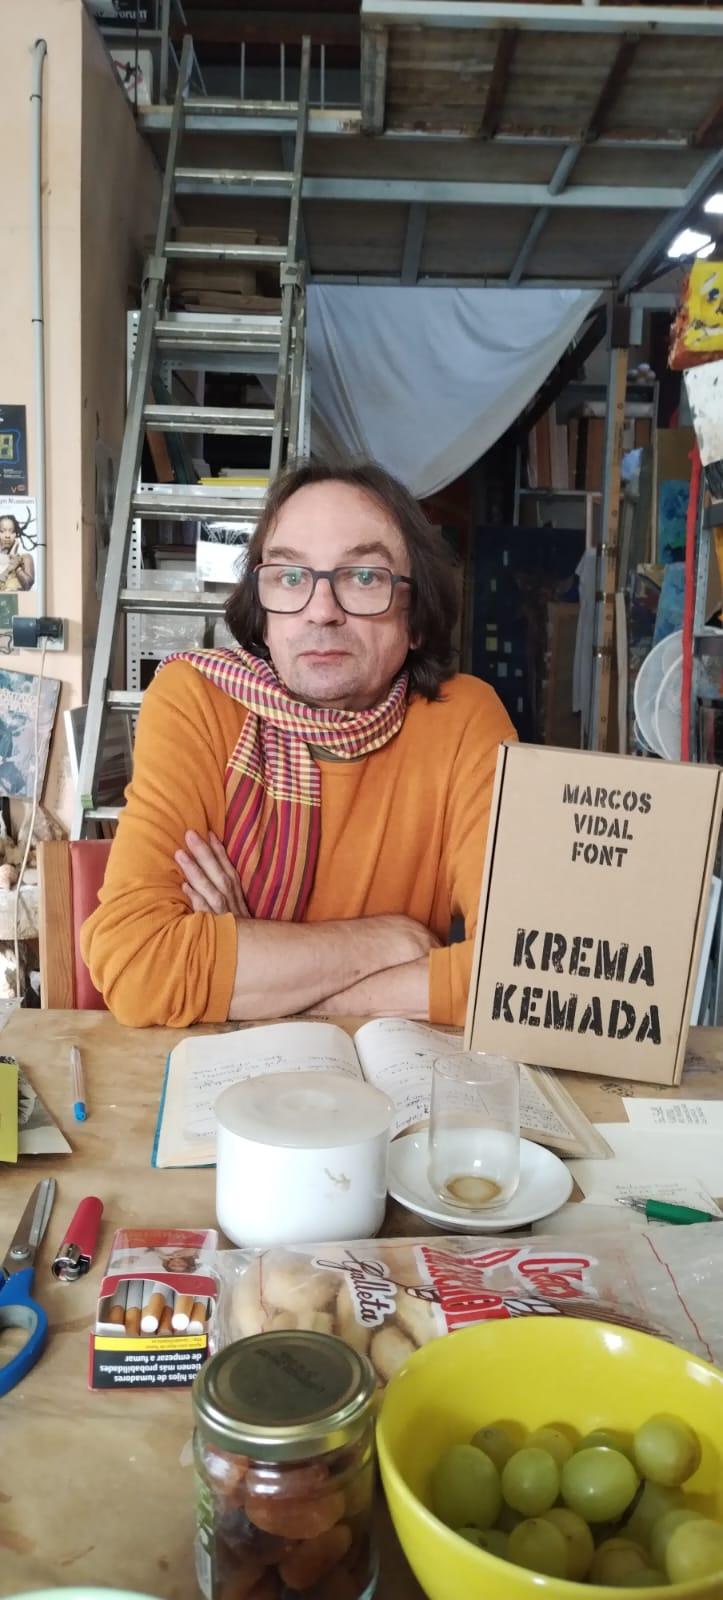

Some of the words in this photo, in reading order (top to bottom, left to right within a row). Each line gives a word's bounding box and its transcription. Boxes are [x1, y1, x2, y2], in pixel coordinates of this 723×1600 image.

[562, 783, 652, 814] MARCOS
[574, 813, 633, 840] VIDAL
[571, 841, 628, 868] FONT
[513, 928, 655, 987] KREMA
[491, 982, 662, 1045] KEMADA
[316, 1250, 392, 1323] Galleta
[125, 1354, 149, 1363] fumar
[157, 1353, 191, 1362] empezar
[191, 1353, 202, 1361] de
[100, 1364, 158, 1374] probabilidades
[159, 1363, 176, 1373] más
[177, 1363, 202, 1371] tienen
[114, 1374, 156, 1383] fumadores
[157, 1374, 167, 1382] de
[168, 1373, 187, 1382] hijos
